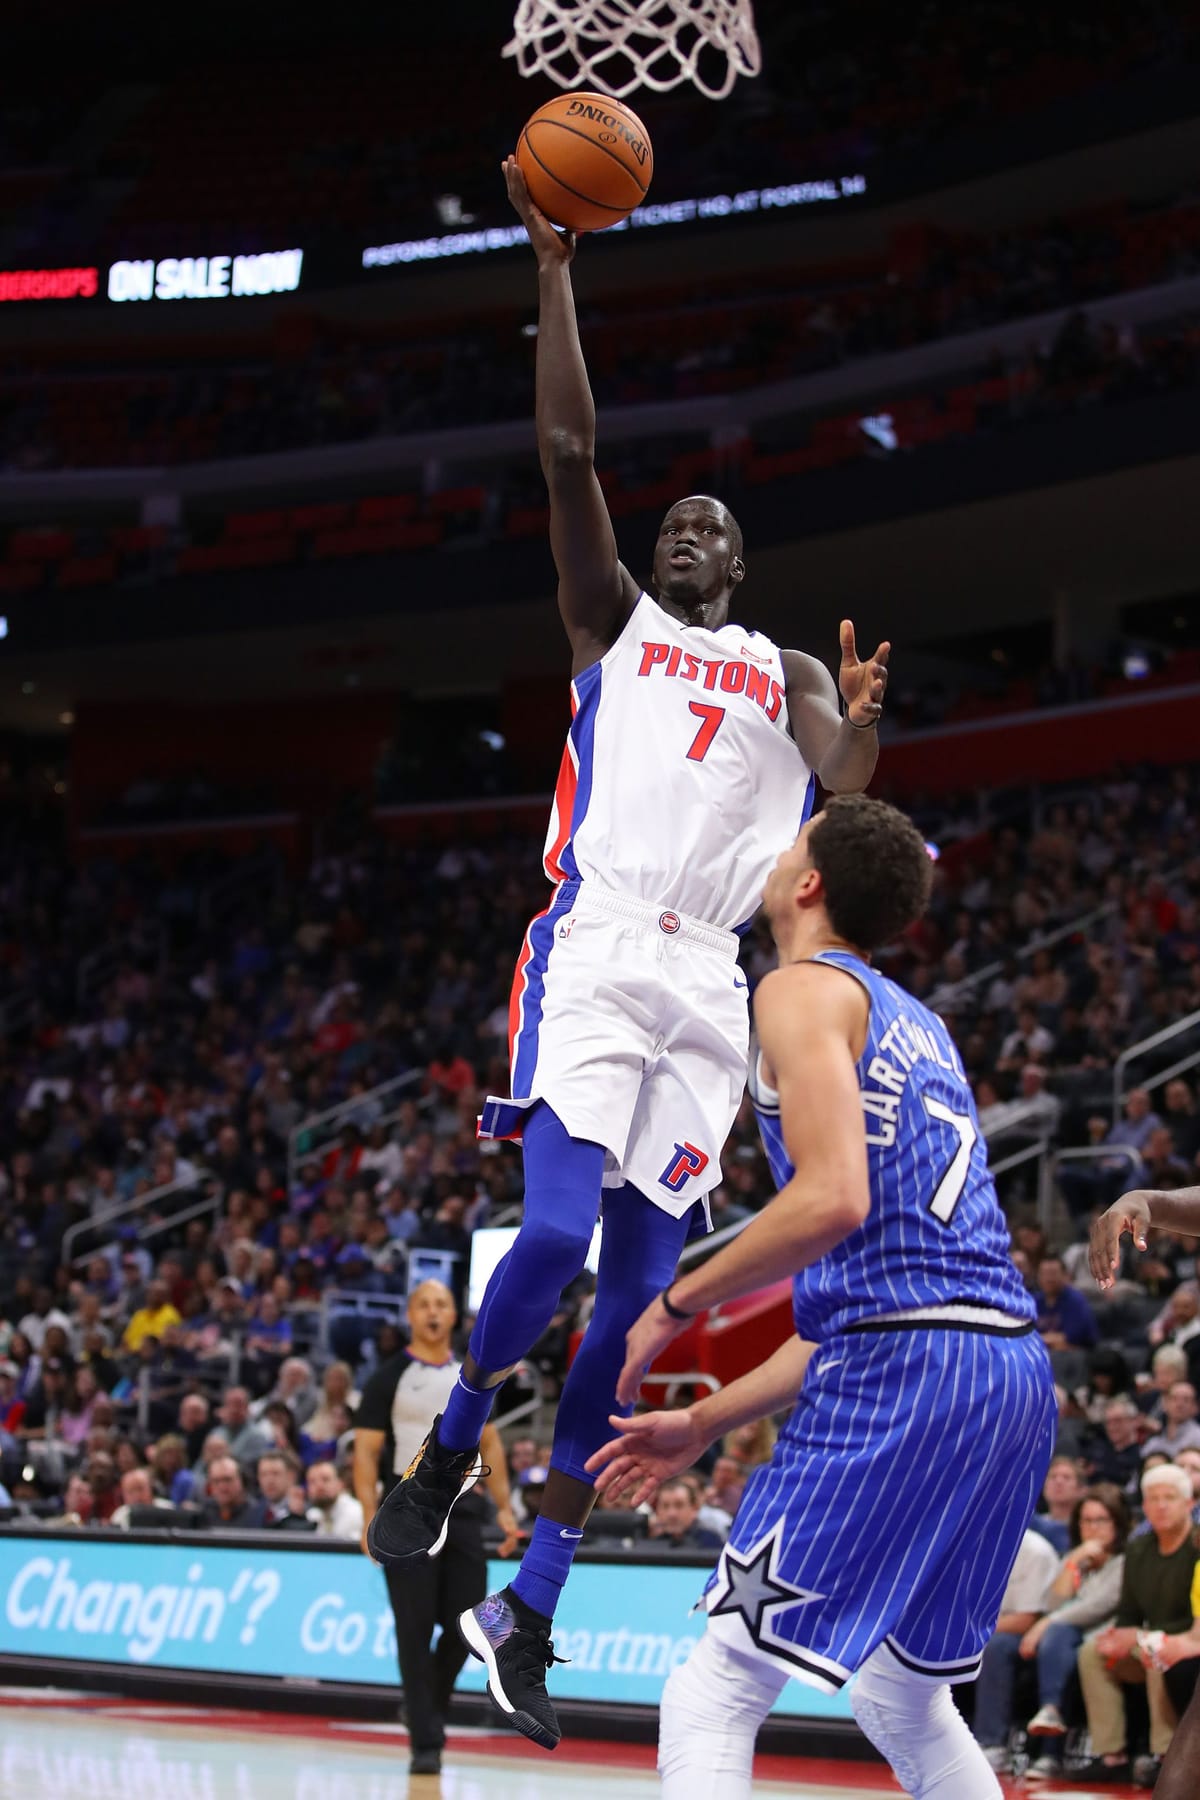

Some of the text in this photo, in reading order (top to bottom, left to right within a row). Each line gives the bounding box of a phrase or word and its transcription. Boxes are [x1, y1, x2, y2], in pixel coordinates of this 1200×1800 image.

[566, 100, 649, 167] SPALDING
[107, 248, 304, 301] ON SALE NOW
[637, 641, 786, 723] PISTONS
[685, 700, 726, 763] 7
[923, 1095, 977, 1225] 7
[6, 1556, 281, 1663] Changin'?
[301, 1593, 367, 1656] Go
